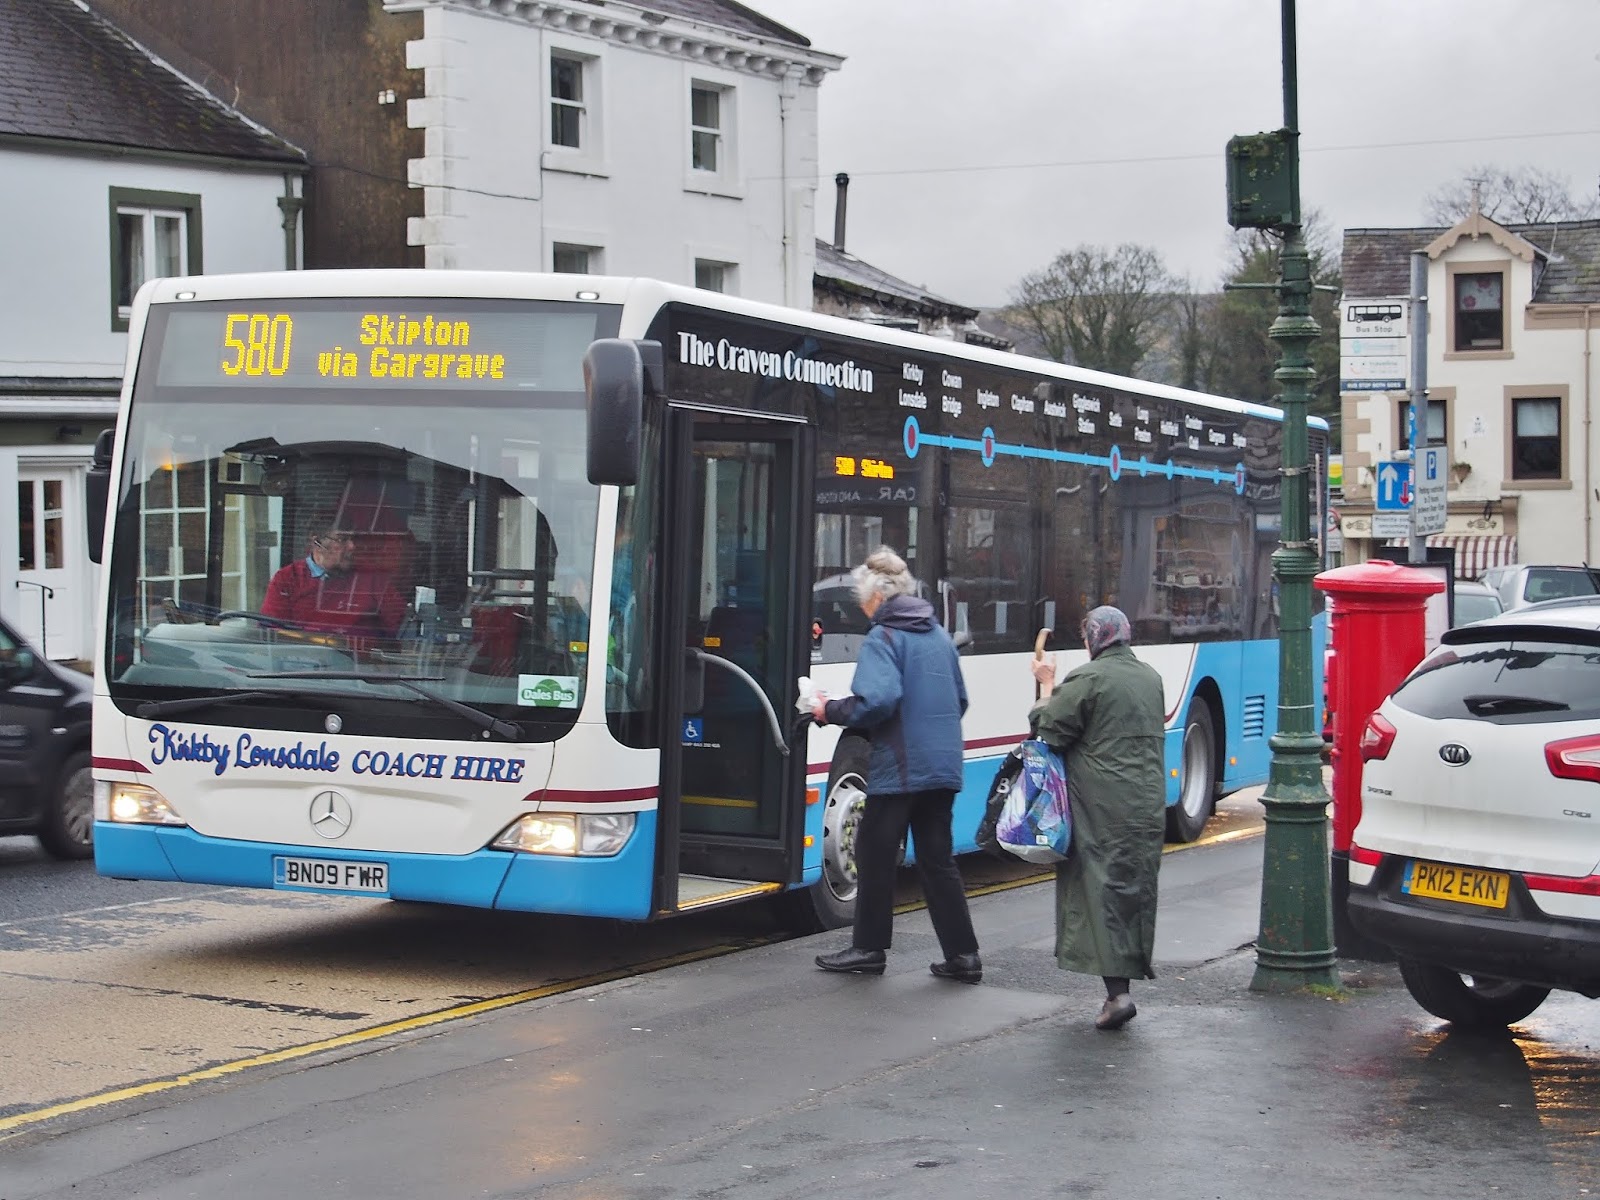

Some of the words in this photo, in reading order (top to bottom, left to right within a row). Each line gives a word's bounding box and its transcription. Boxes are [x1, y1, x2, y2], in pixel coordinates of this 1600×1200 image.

[222, 314, 293, 376] 580
[360, 314, 470, 346] Skipton
[318, 347, 358, 377] via
[369, 347, 505, 379] Gargrave
[677, 331, 715, 368] The
[717, 338, 782, 379] Craven
[783, 350, 873, 393] Connection
[523, 689, 552, 701] Dales
[552, 690, 573, 701] Bus
[148, 723, 230, 776] Kirkby
[234, 733, 340, 774] Lonsdale
[351, 750, 446, 778] COACH
[450, 756, 525, 783] HIRE
[1442, 746, 1465, 762] KIA
[287, 862, 338, 885] BN09
[345, 865, 383, 888] FWR
[1416, 865, 1455, 893] PK12
[1459, 872, 1500, 900] EKN
